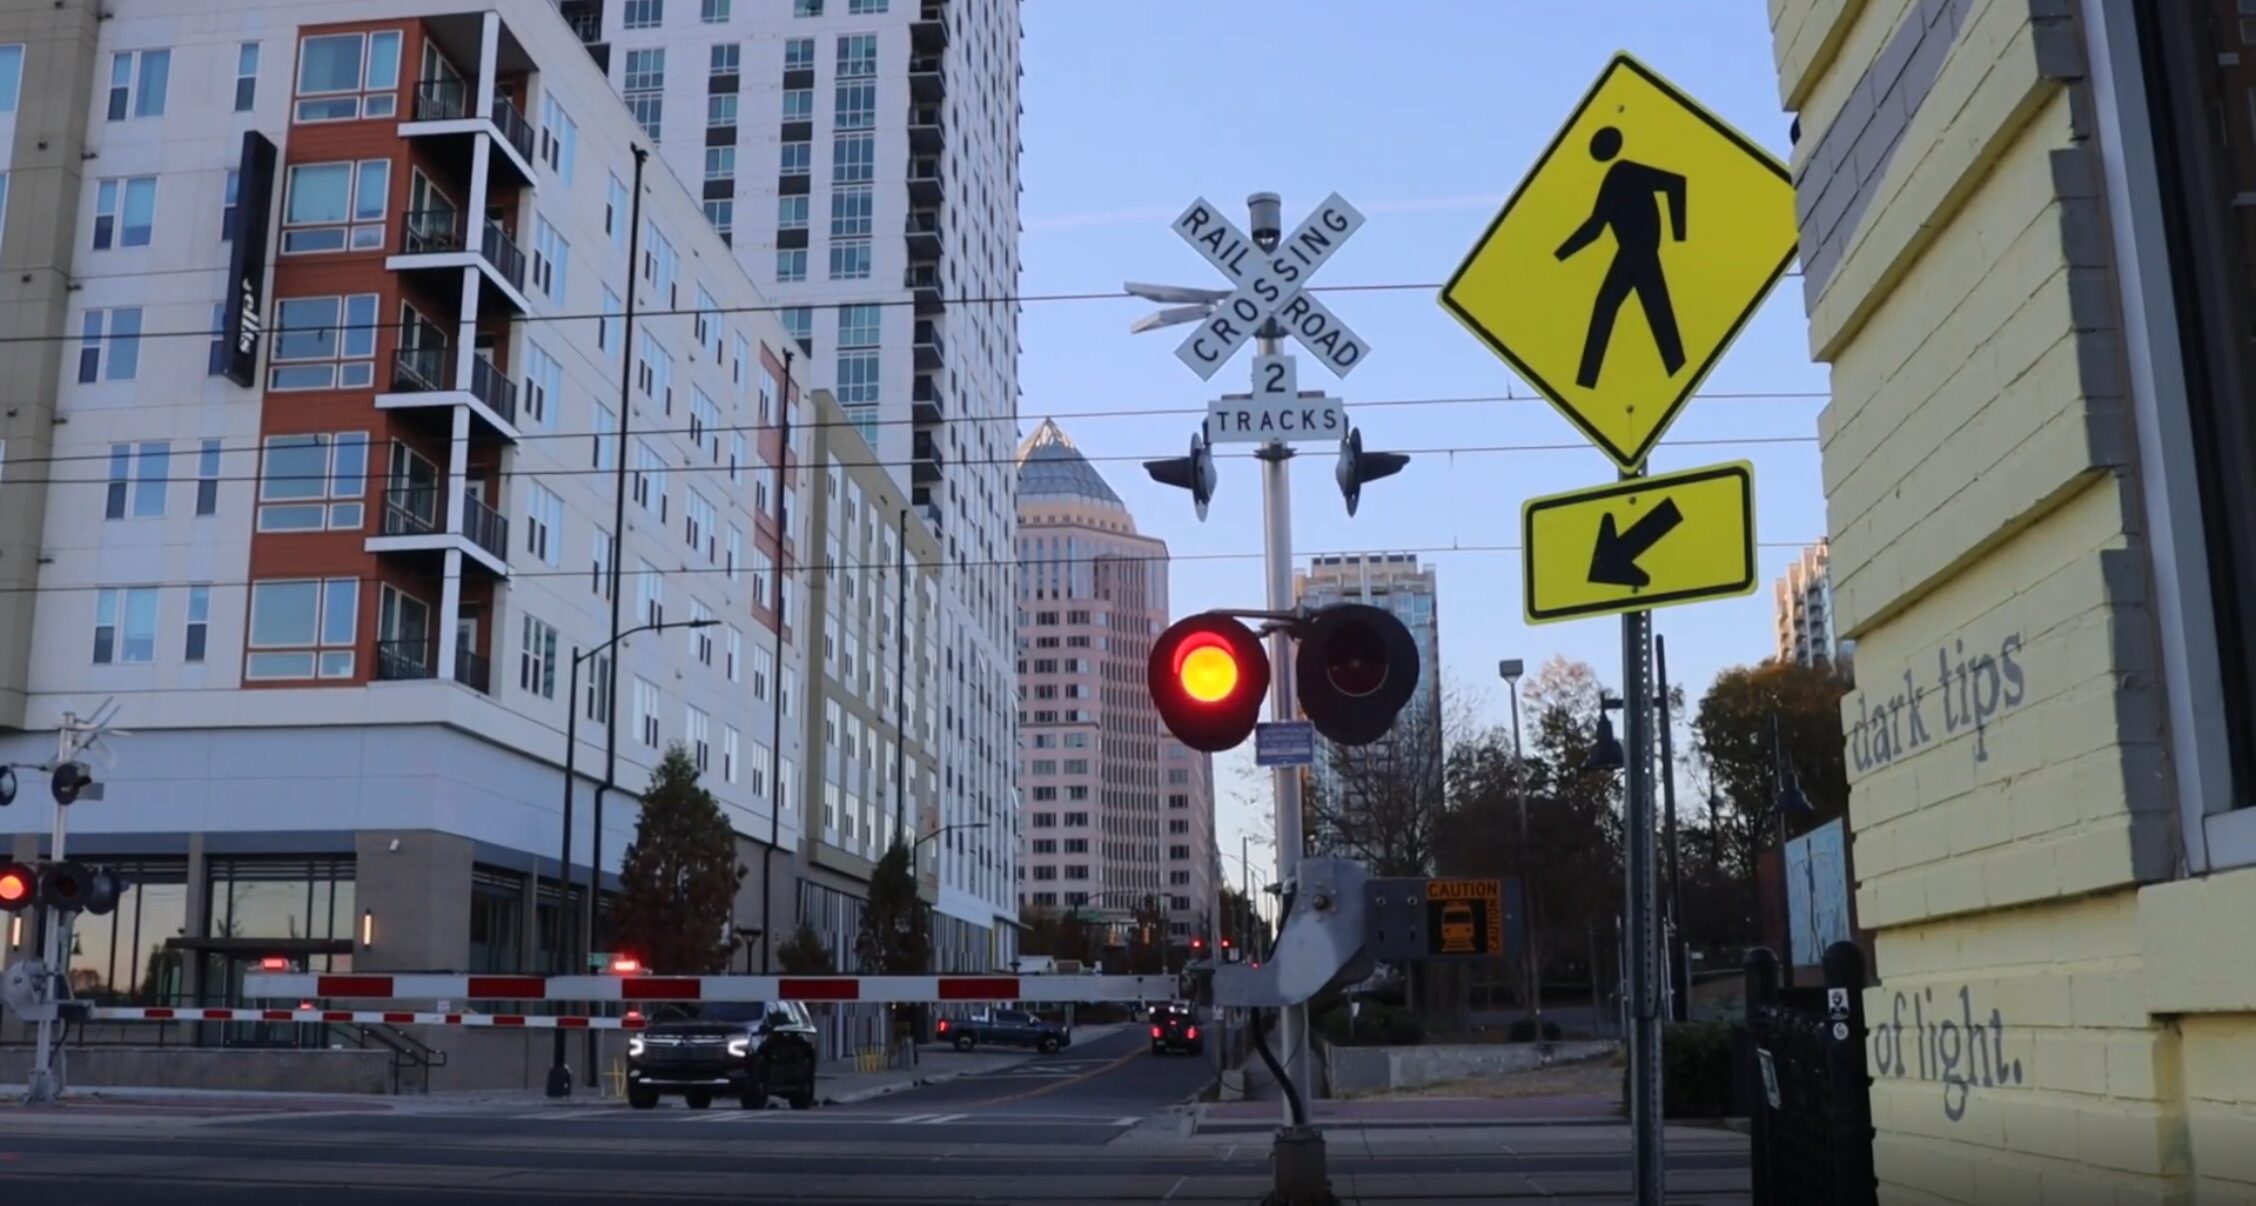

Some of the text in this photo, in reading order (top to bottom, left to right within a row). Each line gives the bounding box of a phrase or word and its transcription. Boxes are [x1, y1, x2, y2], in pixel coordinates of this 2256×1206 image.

[1182, 206, 1359, 367] RAIL ROAD
[1193, 209, 1348, 363] CROSSING
[1216, 409, 1337, 431] TRACKS
[1265, 363, 1286, 393] 2
[1853, 631, 2025, 773] dark tips
[1428, 881, 1497, 897] CAUTION
[1875, 984, 2022, 1122] of light.
